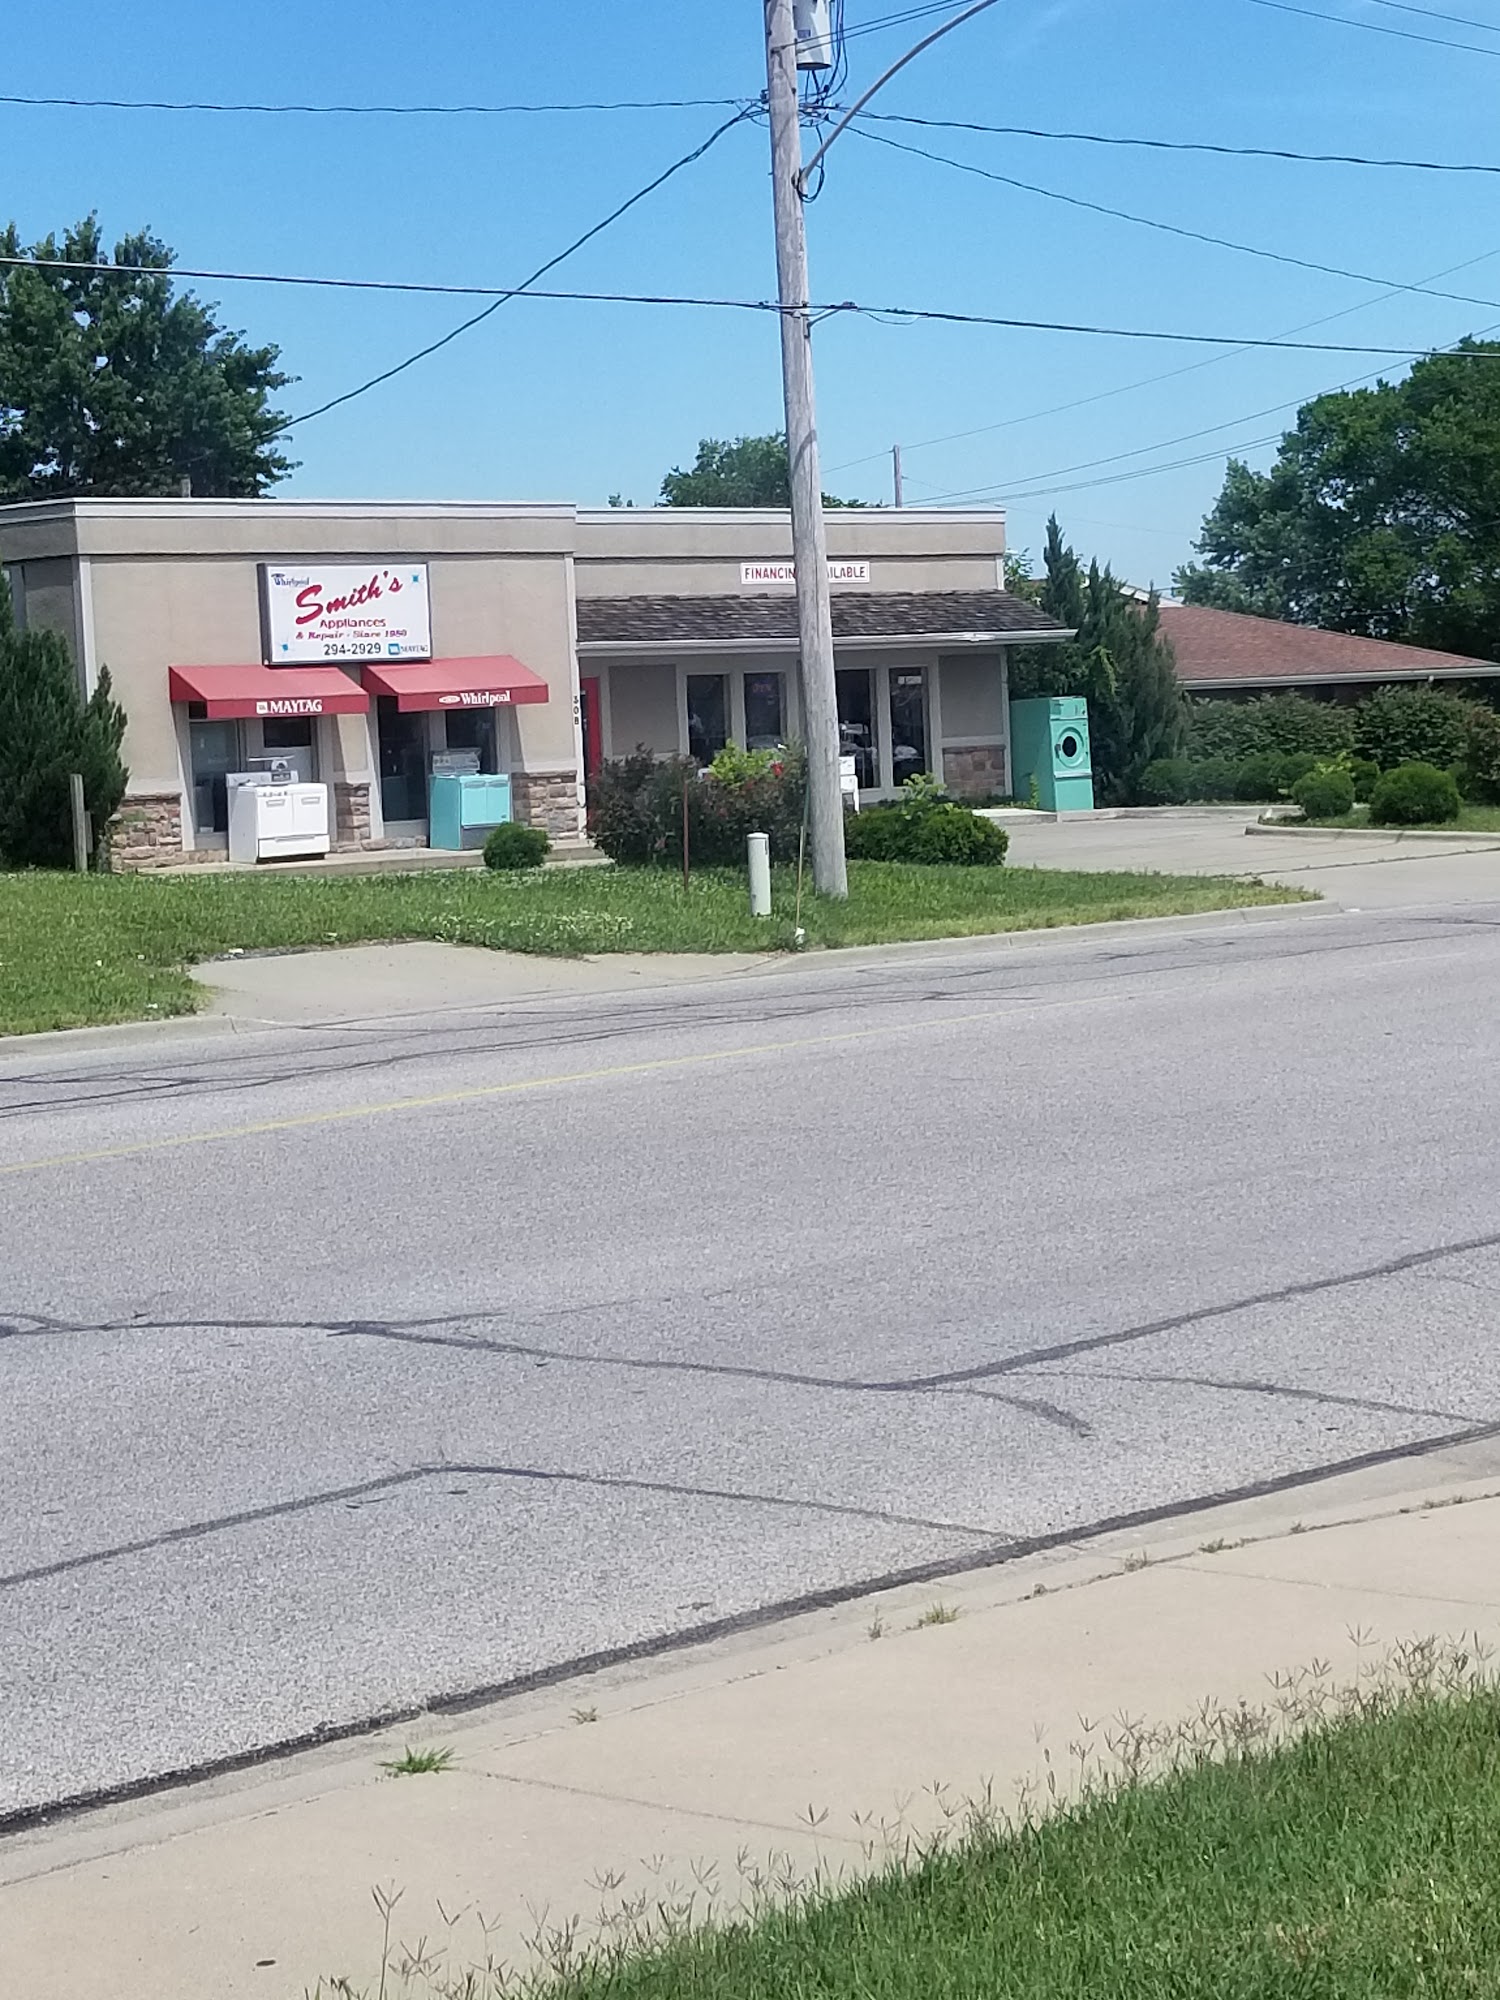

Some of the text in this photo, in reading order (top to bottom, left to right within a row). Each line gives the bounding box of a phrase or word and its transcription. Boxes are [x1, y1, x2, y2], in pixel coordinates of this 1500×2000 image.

[744, 566, 866, 580] FINANCIN ILABLE
[295, 570, 403, 625] Smith's
[319, 618, 387, 630] Appliances
[308, 631, 344, 642] Repair
[352, 630, 381, 639] Since
[323, 642, 382, 656] 294-2929
[460, 689, 511, 707] Whirlpool
[270, 699, 323, 714] MAYTAG
